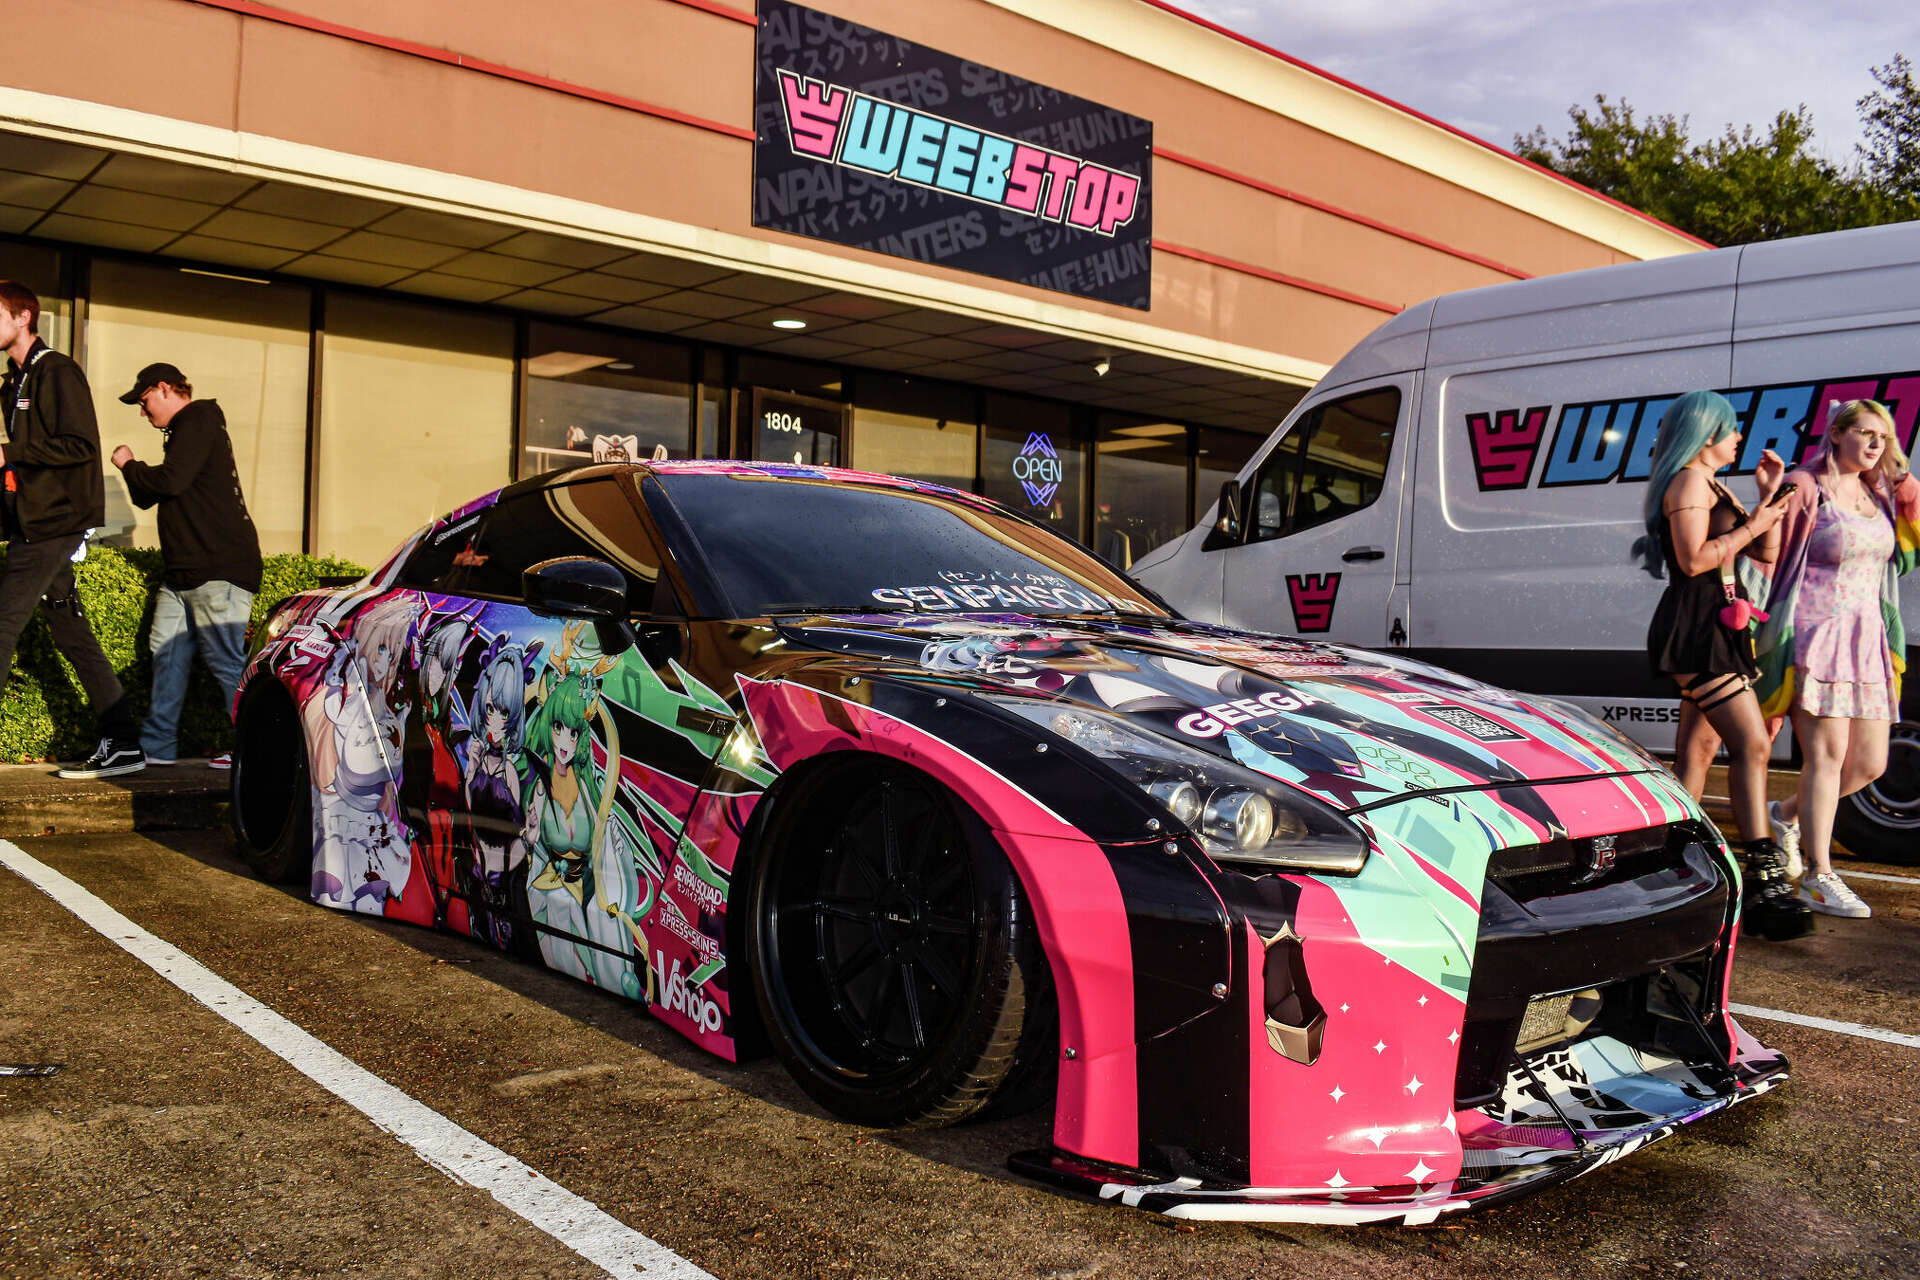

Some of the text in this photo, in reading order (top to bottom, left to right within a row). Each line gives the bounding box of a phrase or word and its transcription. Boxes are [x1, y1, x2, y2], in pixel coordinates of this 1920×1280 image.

[838, 94, 1140, 235] WEEBSTOP
[765, 412, 802, 434] 1804
[1012, 456, 1062, 482] OPEN
[1175, 687, 1334, 739] GEEGA
[1601, 705, 1681, 723] XPRESS
